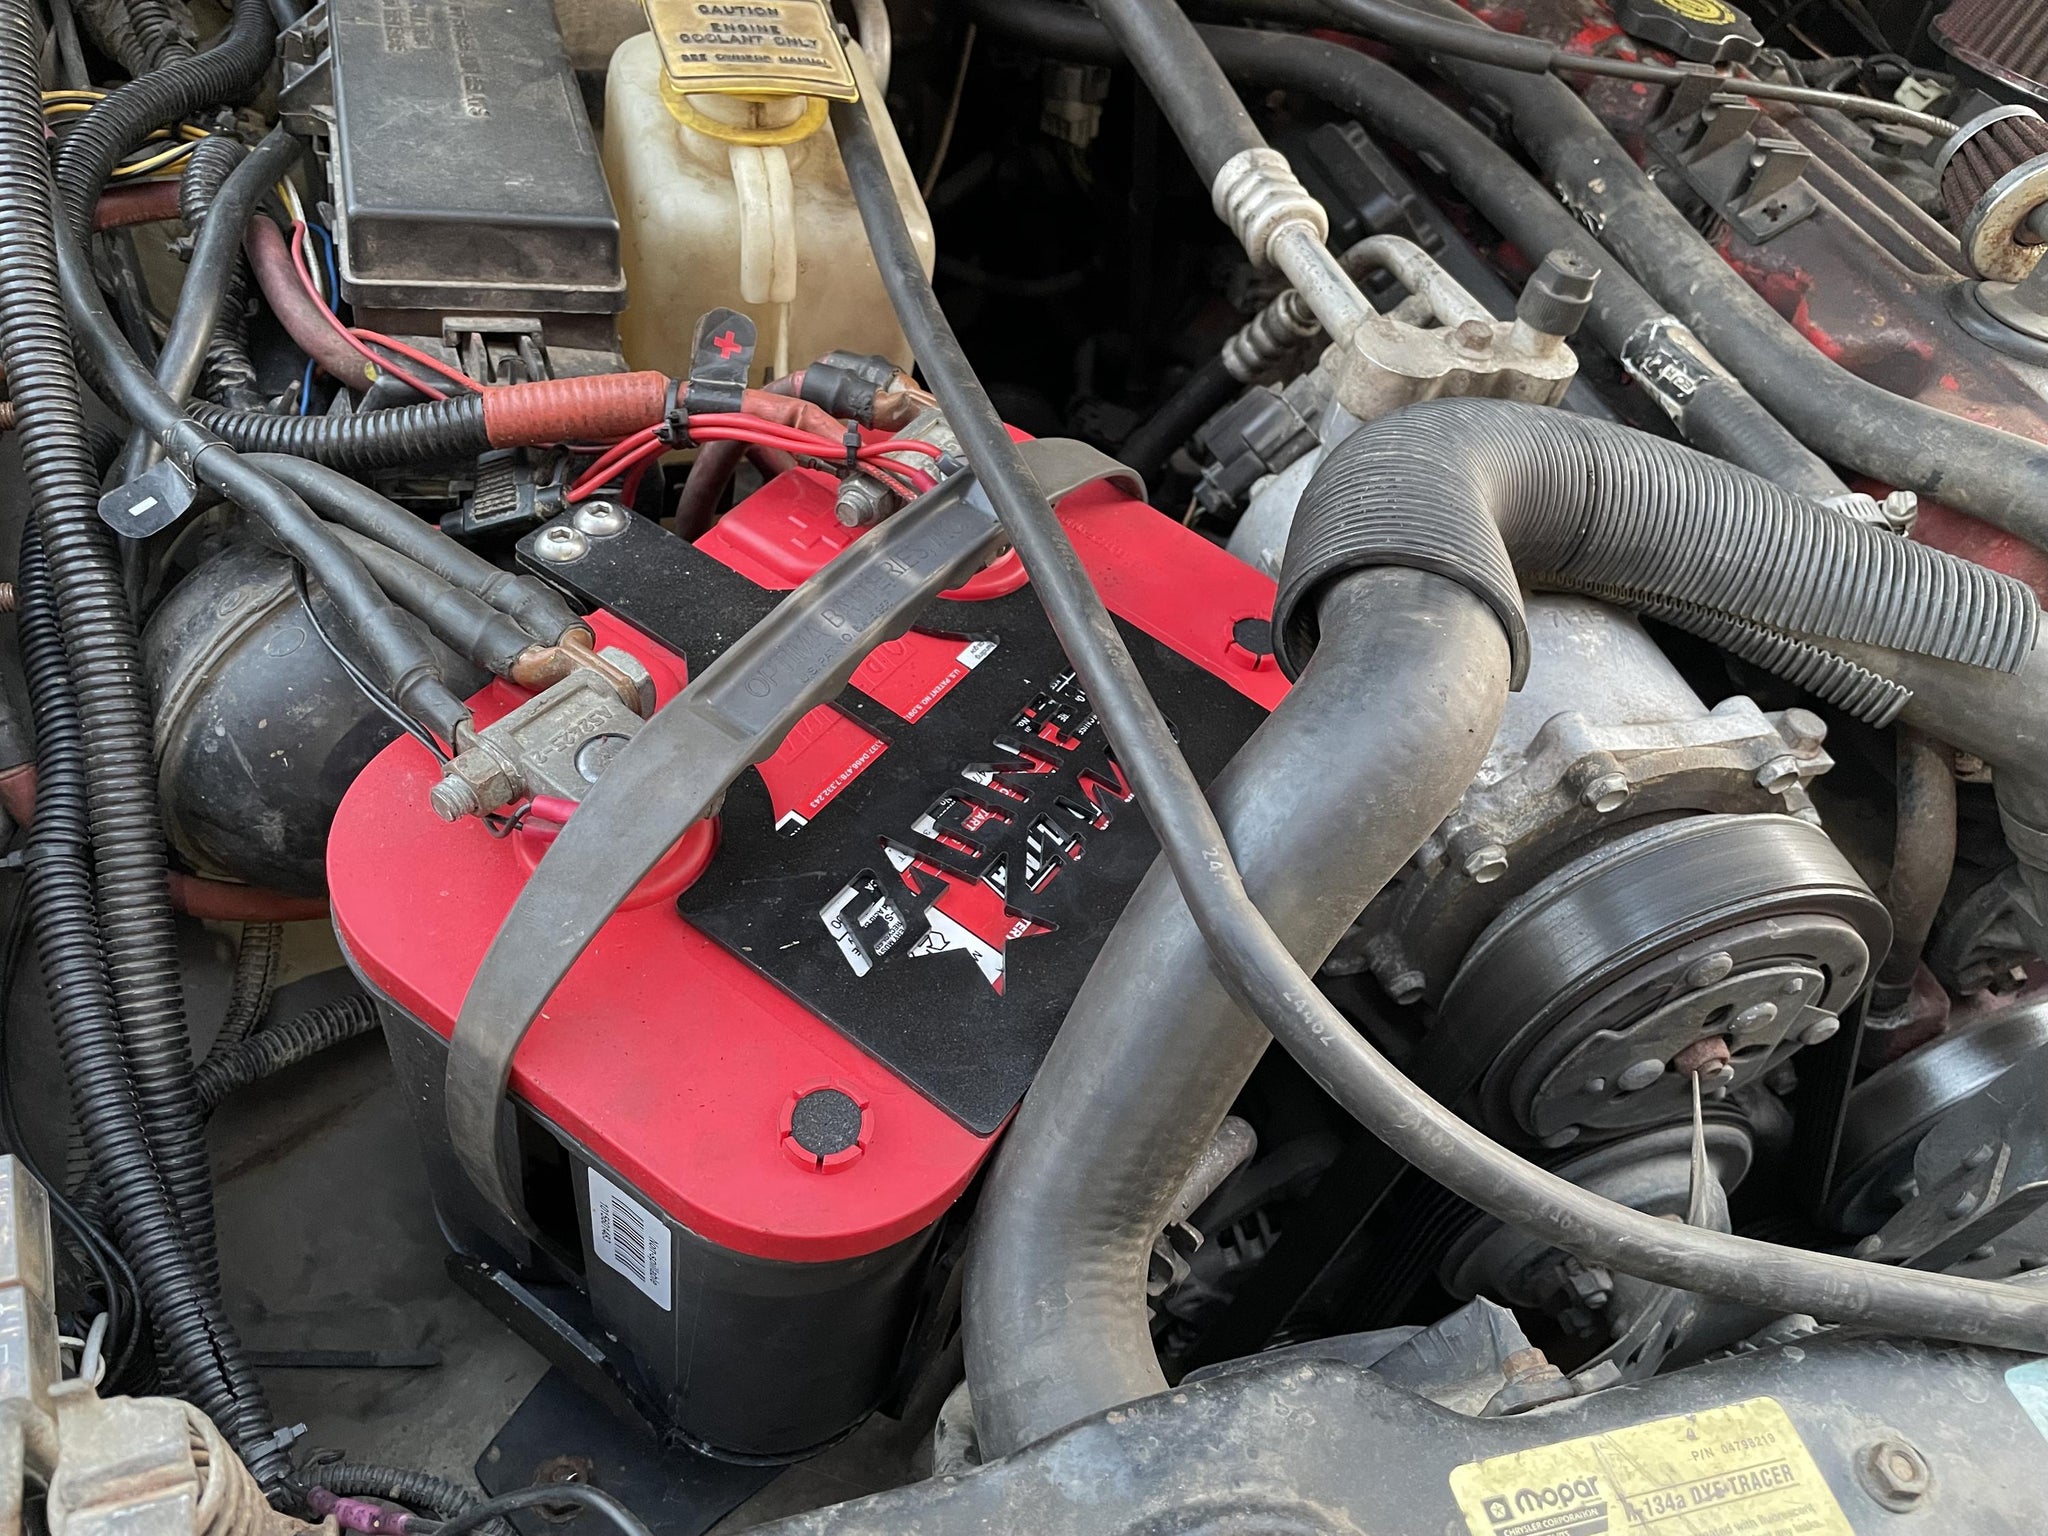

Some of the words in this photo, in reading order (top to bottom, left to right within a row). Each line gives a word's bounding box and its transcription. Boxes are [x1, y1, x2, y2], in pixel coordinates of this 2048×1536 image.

[698, 4, 779, 17] CAUTION
[710, 22, 781, 35] ENGINE
[679, 33, 763, 45] COOLANT
[773, 36, 818, 49] ONLY
[949, 668, 961, 680] U.S.
[928, 676, 951, 698] PATENT
[919, 694, 932, 707] NO.
[903, 702, 923, 722] 5,091,
[1691, 1447, 1715, 1462] P/N
[1727, 1463, 1795, 1495] TRACER
[1503, 1521, 1542, 1536] CHRYSLER
[1542, 1507, 1599, 1528] CORPORATION
